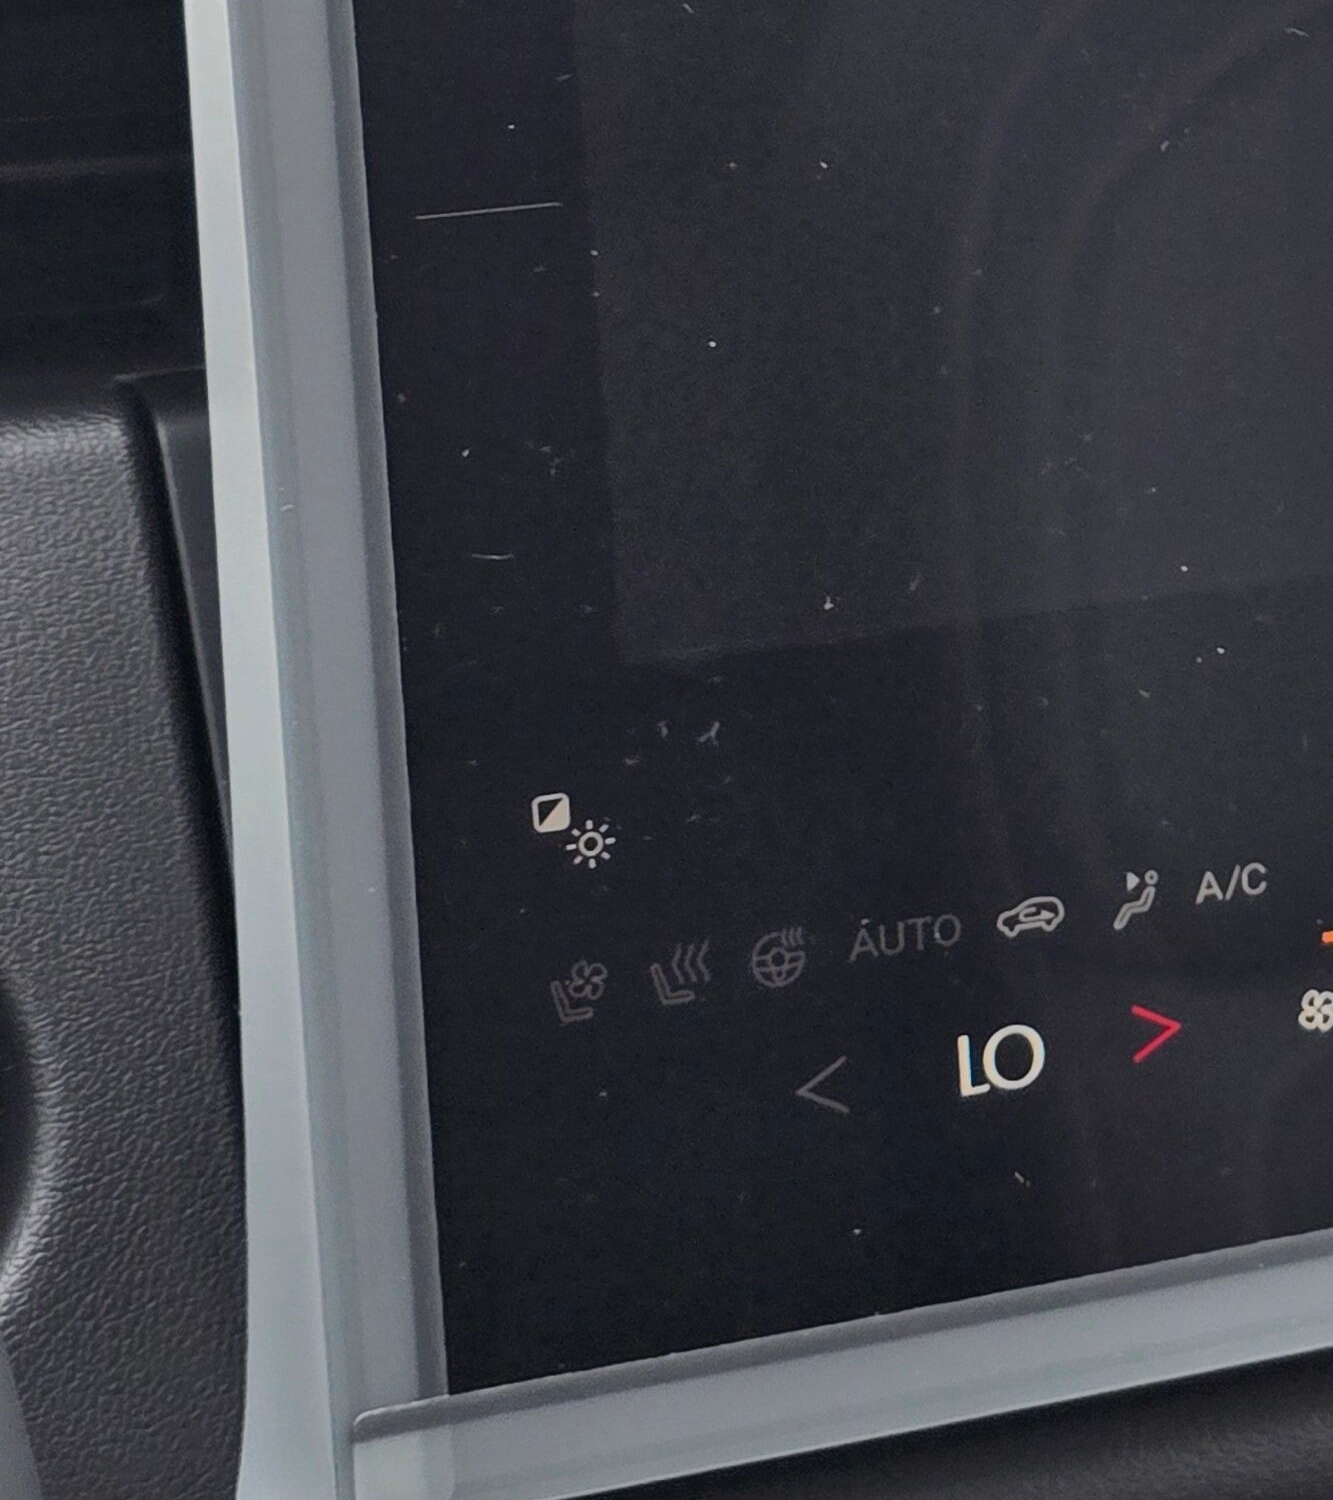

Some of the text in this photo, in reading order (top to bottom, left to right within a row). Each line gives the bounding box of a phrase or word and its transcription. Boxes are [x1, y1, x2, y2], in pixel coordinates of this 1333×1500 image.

[1196, 861, 1269, 905] A/C
[848, 912, 963, 964] AUTO
[956, 1022, 1047, 1099] LO
